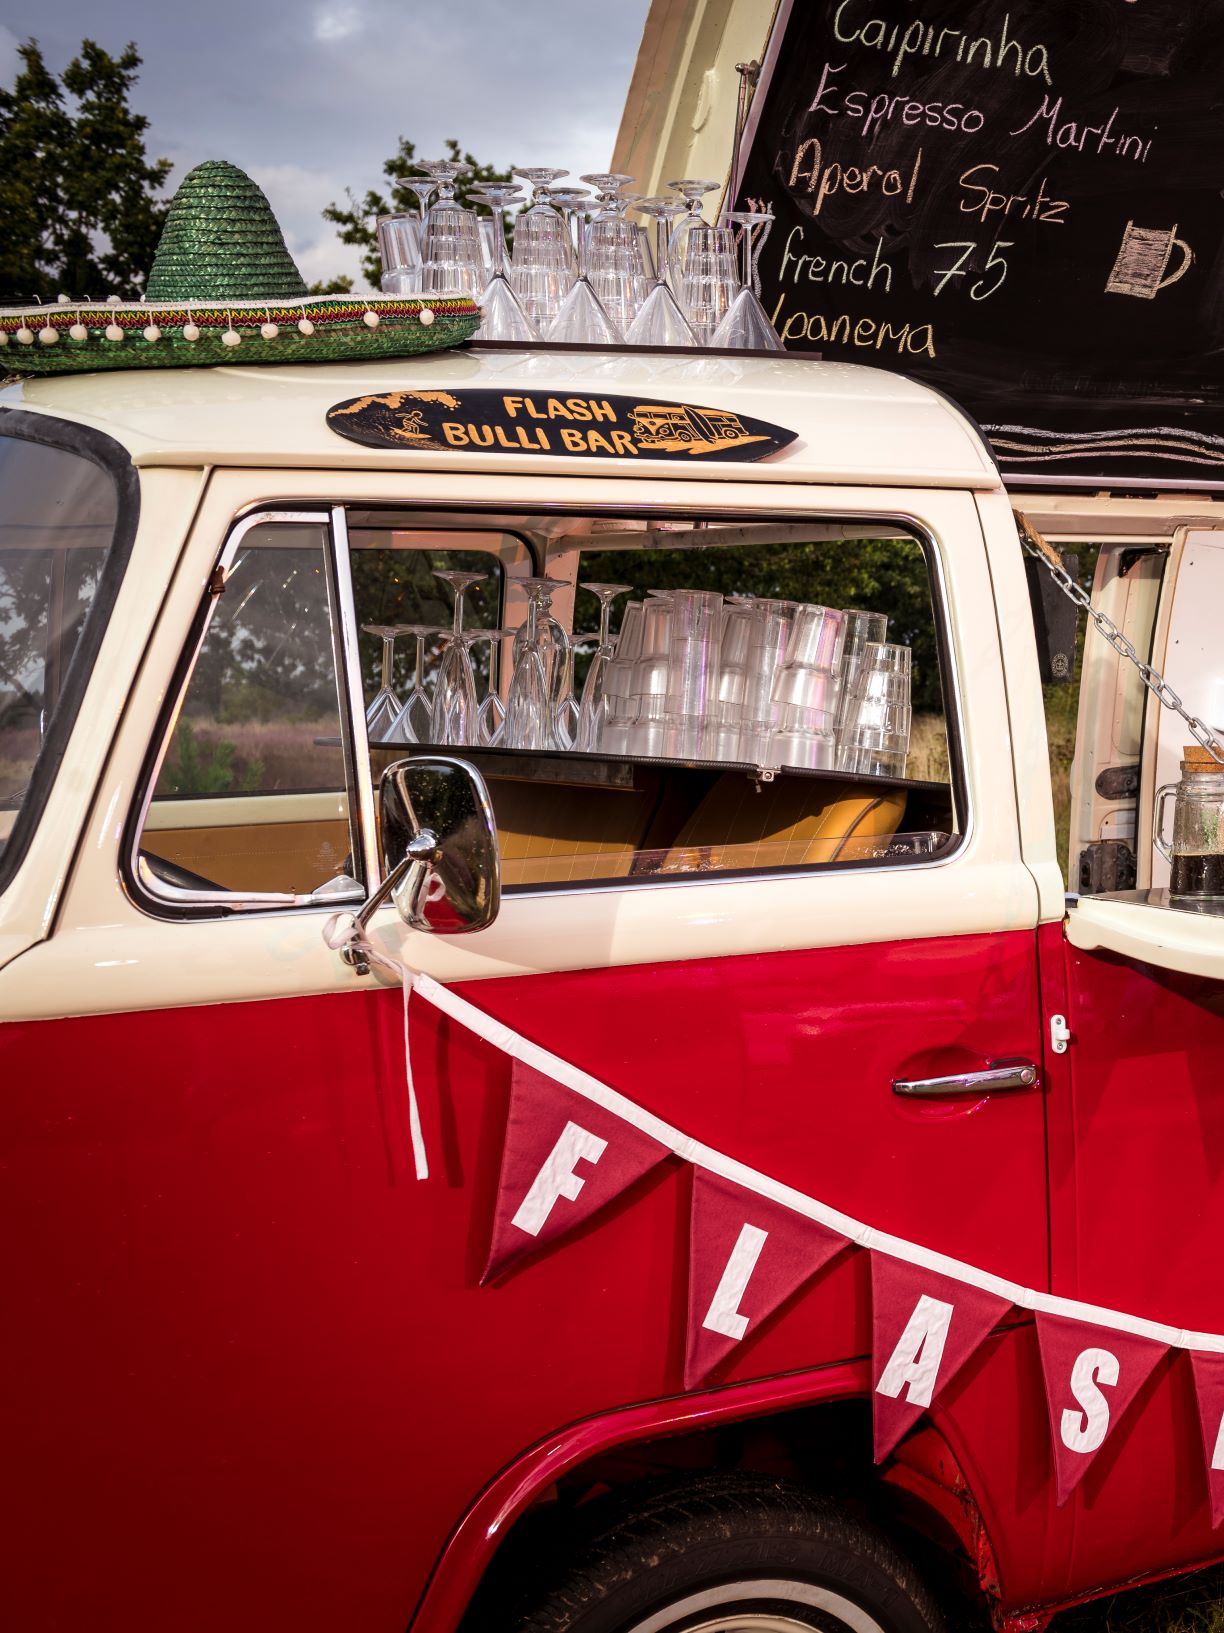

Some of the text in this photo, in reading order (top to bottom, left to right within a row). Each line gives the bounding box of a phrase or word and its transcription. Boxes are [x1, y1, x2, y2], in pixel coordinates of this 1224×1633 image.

[834, 0, 1053, 85] Caipirinha
[809, 63, 1158, 163] Espresso Martini
[788, 138, 1070, 225] Aperol Spritz
[934, 241, 1015, 301] 75
[442, 421, 639, 456] BULLI BAR
[502, 396, 617, 423] FLASH
